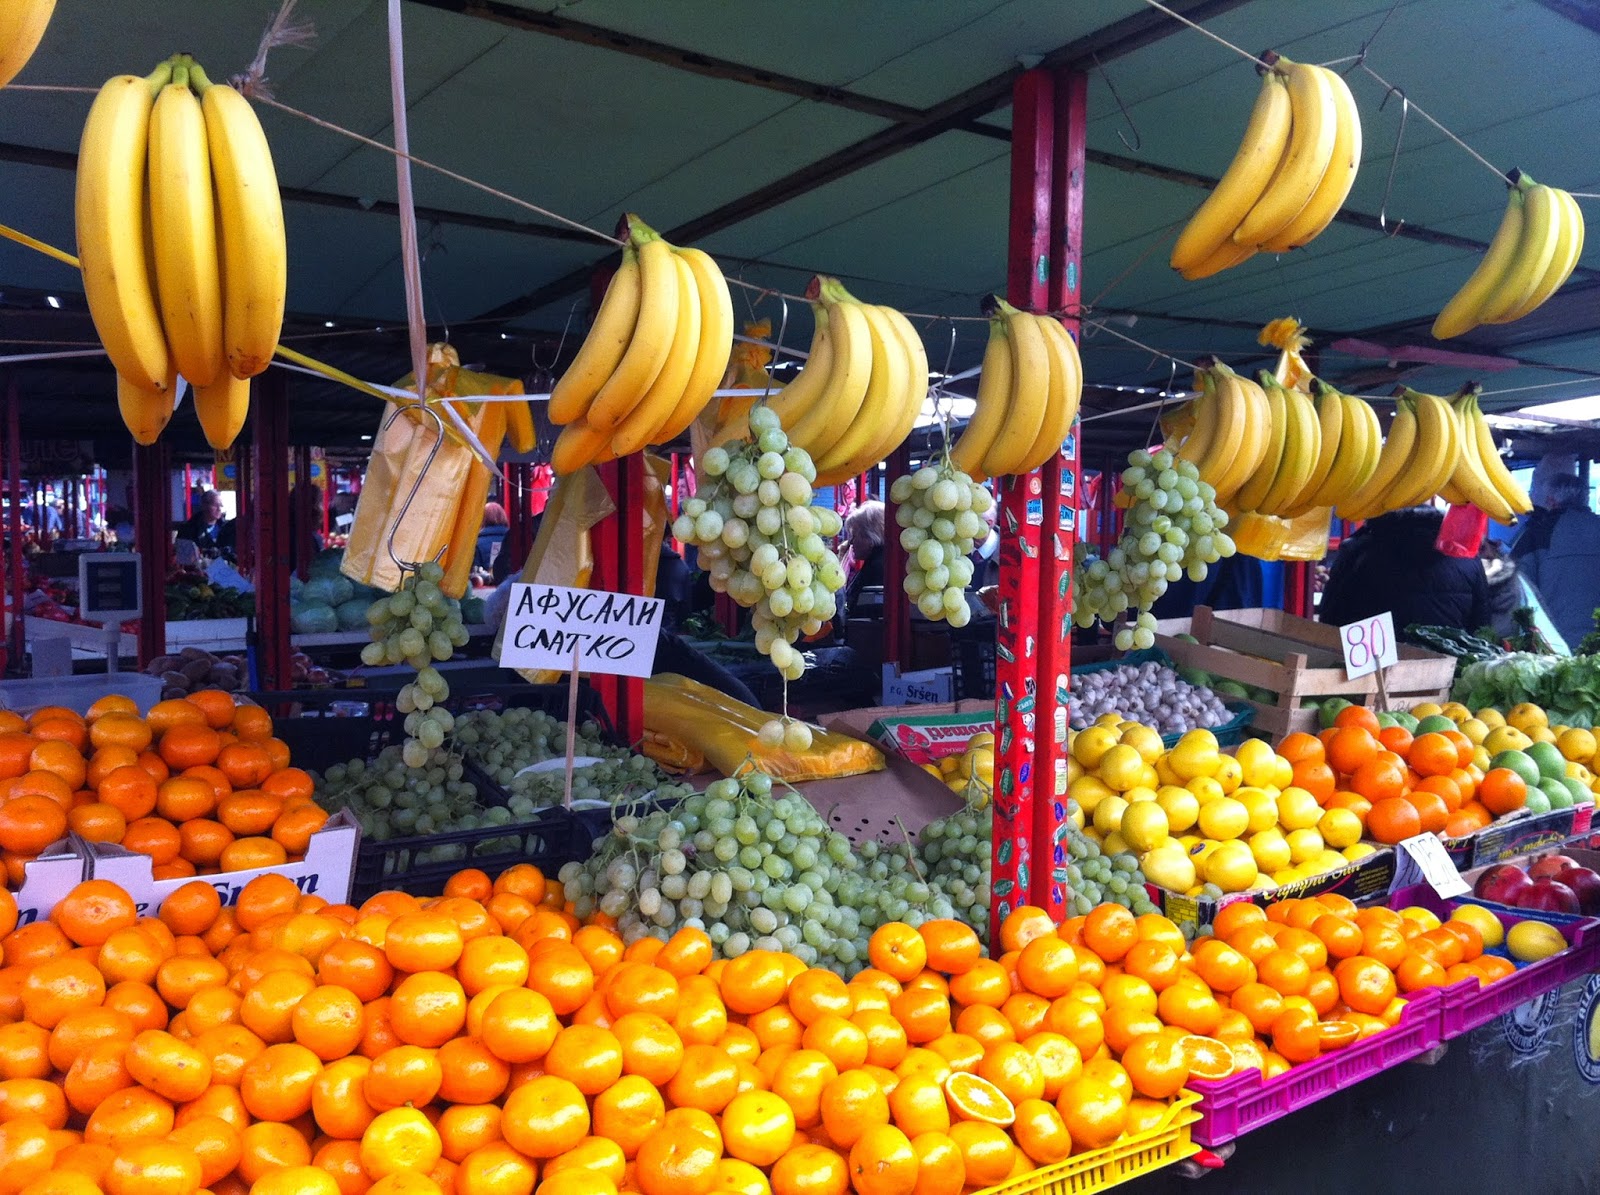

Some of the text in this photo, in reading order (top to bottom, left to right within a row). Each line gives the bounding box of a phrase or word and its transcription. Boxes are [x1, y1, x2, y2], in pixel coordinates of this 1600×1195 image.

[515, 586, 659, 627] АФУСАЛИ
[514, 624, 636, 660] СЛАТКО
[1346, 618, 1386, 668] 80
[906, 685, 939, 703] Sršen
